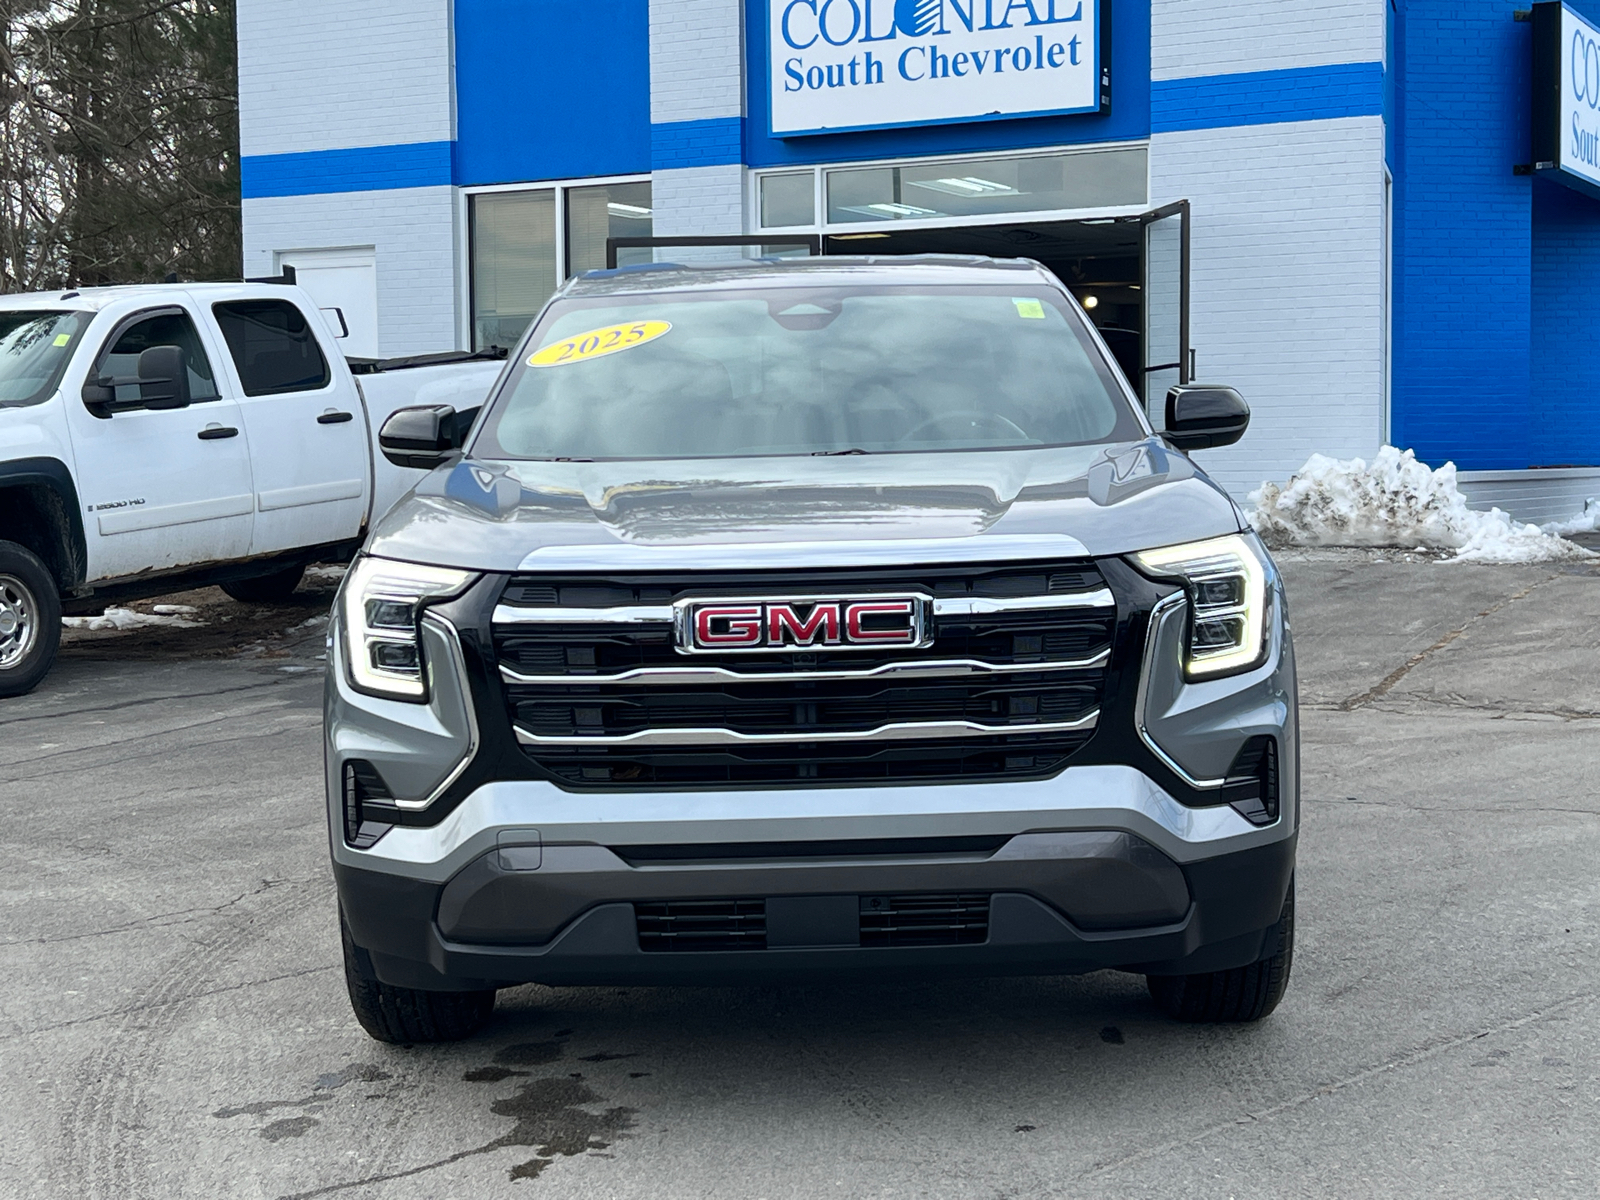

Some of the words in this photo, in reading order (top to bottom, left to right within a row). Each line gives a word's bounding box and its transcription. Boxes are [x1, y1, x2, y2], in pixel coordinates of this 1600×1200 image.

[784, 51, 884, 92] South
[898, 34, 1082, 81] Chevrolet
[1572, 29, 1600, 110] CO
[1571, 111, 1600, 169] Sout
[554, 323, 647, 362] 2025
[695, 601, 912, 647] GMC
